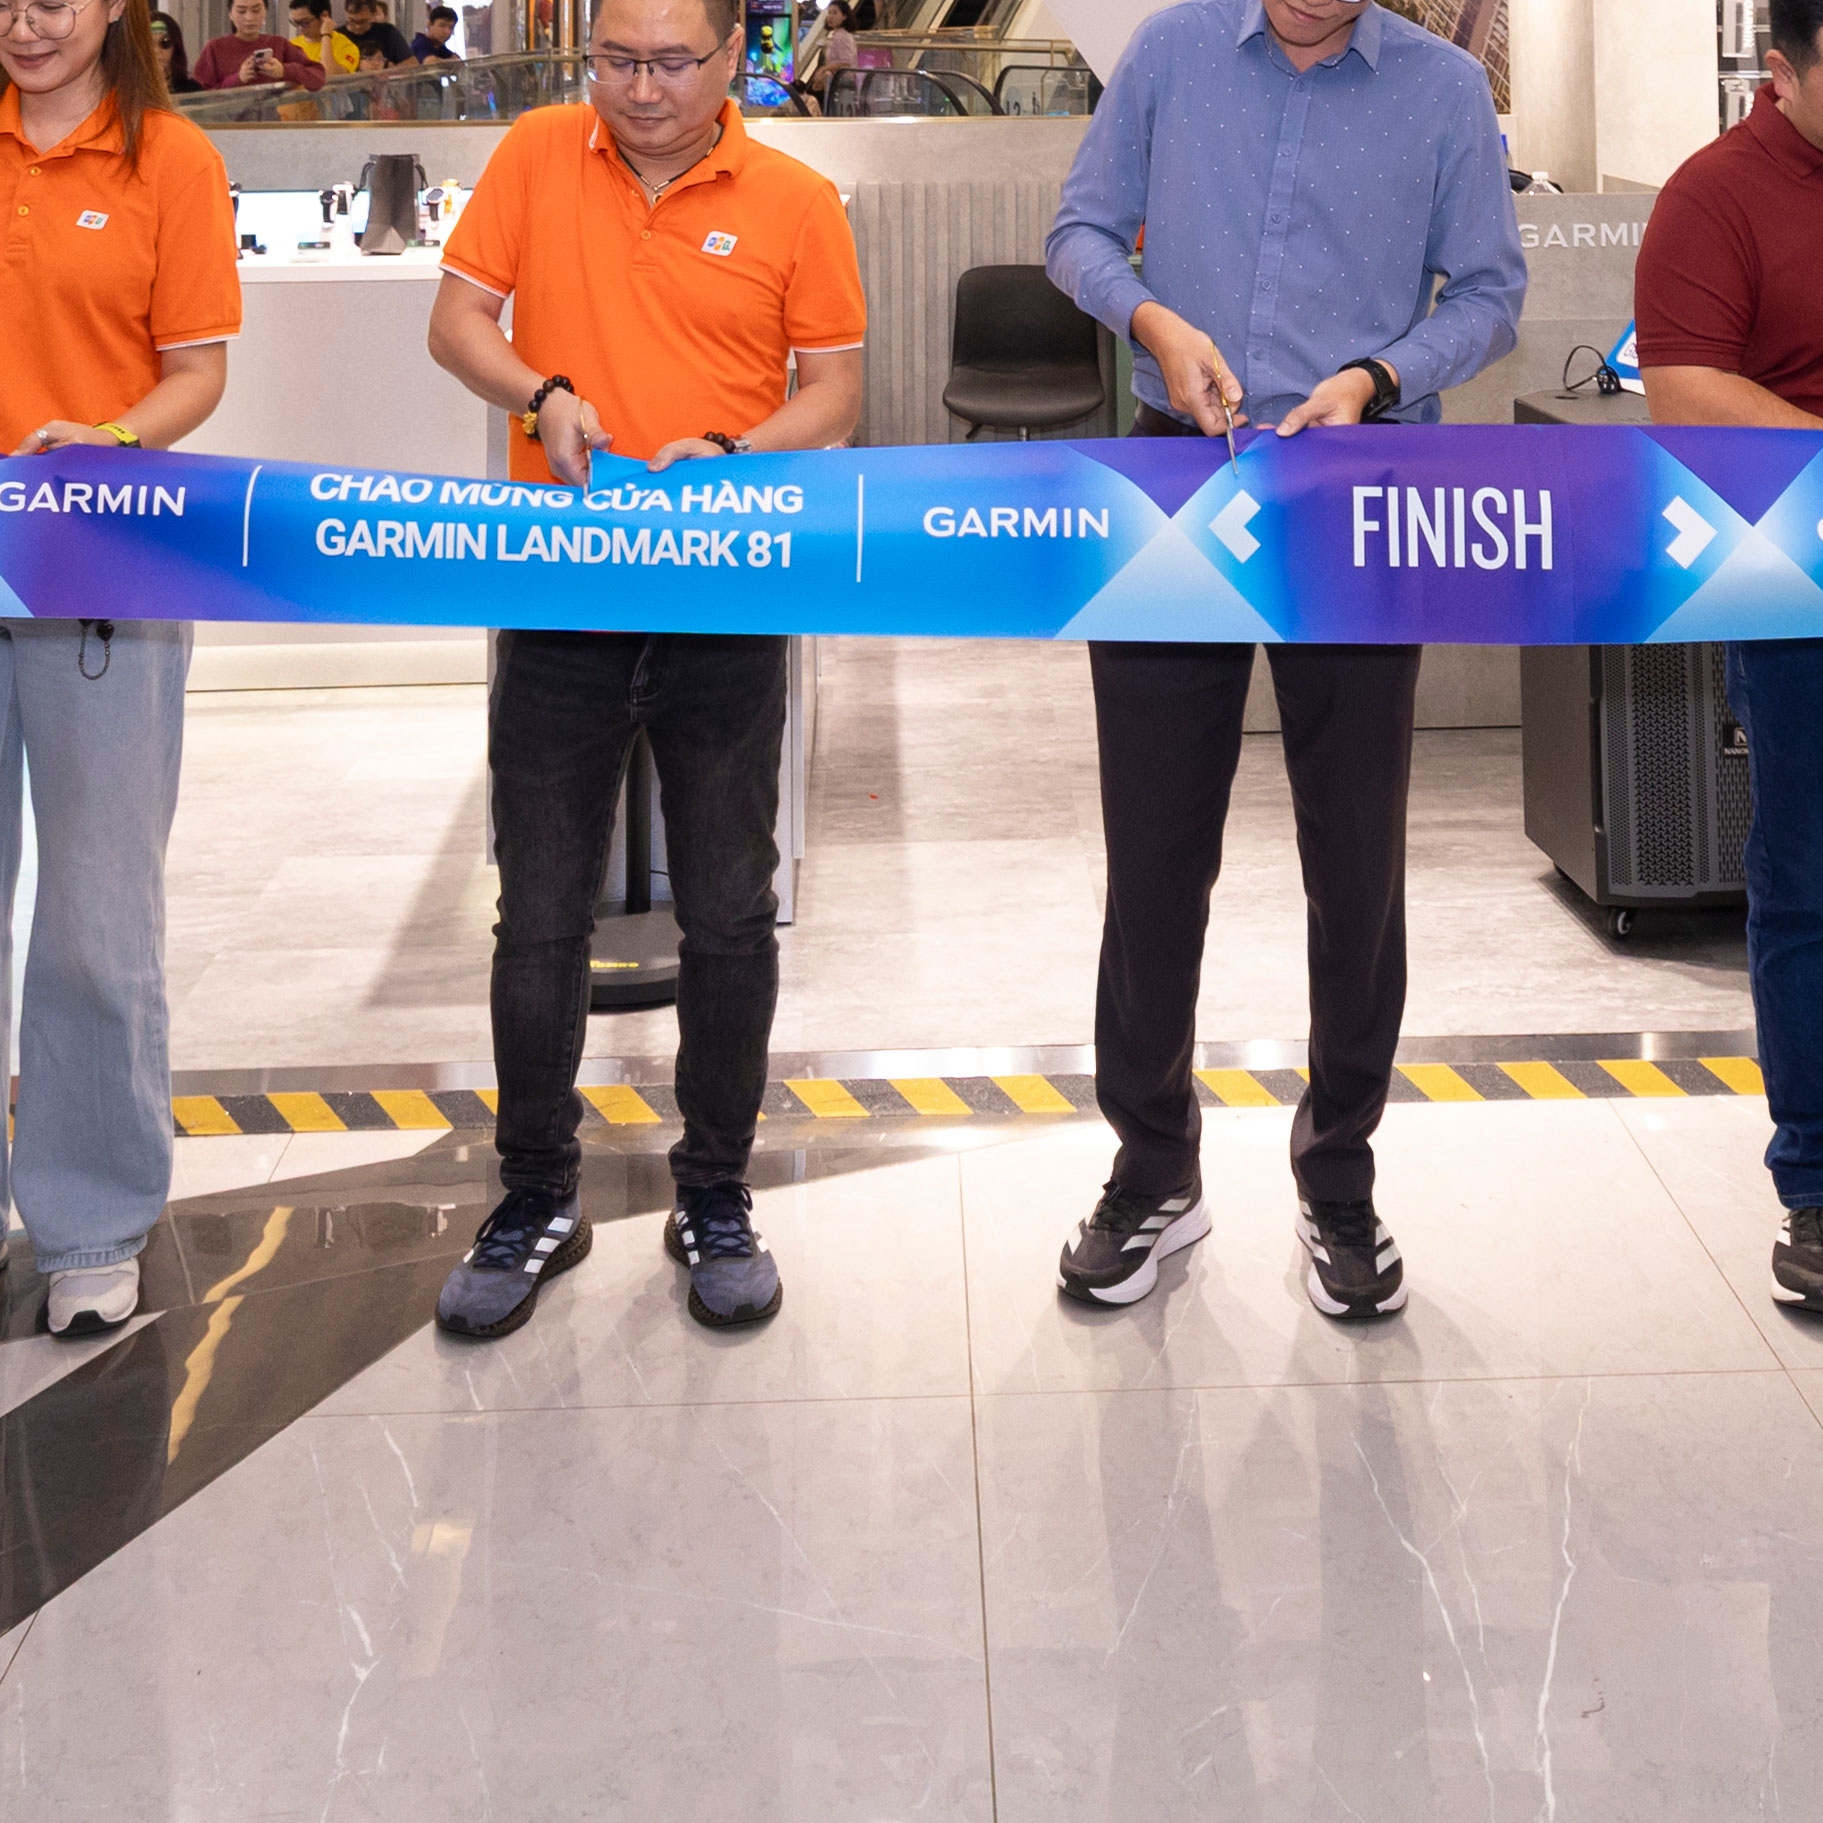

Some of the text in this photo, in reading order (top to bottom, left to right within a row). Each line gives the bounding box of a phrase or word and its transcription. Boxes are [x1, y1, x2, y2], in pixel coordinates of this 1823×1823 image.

[680, 473, 804, 515] HÀNG
[313, 517, 793, 570] GARMIN LANDMARK 81
[922, 506, 1111, 540] GARMIN
[1351, 485, 1555, 571] FINISH
